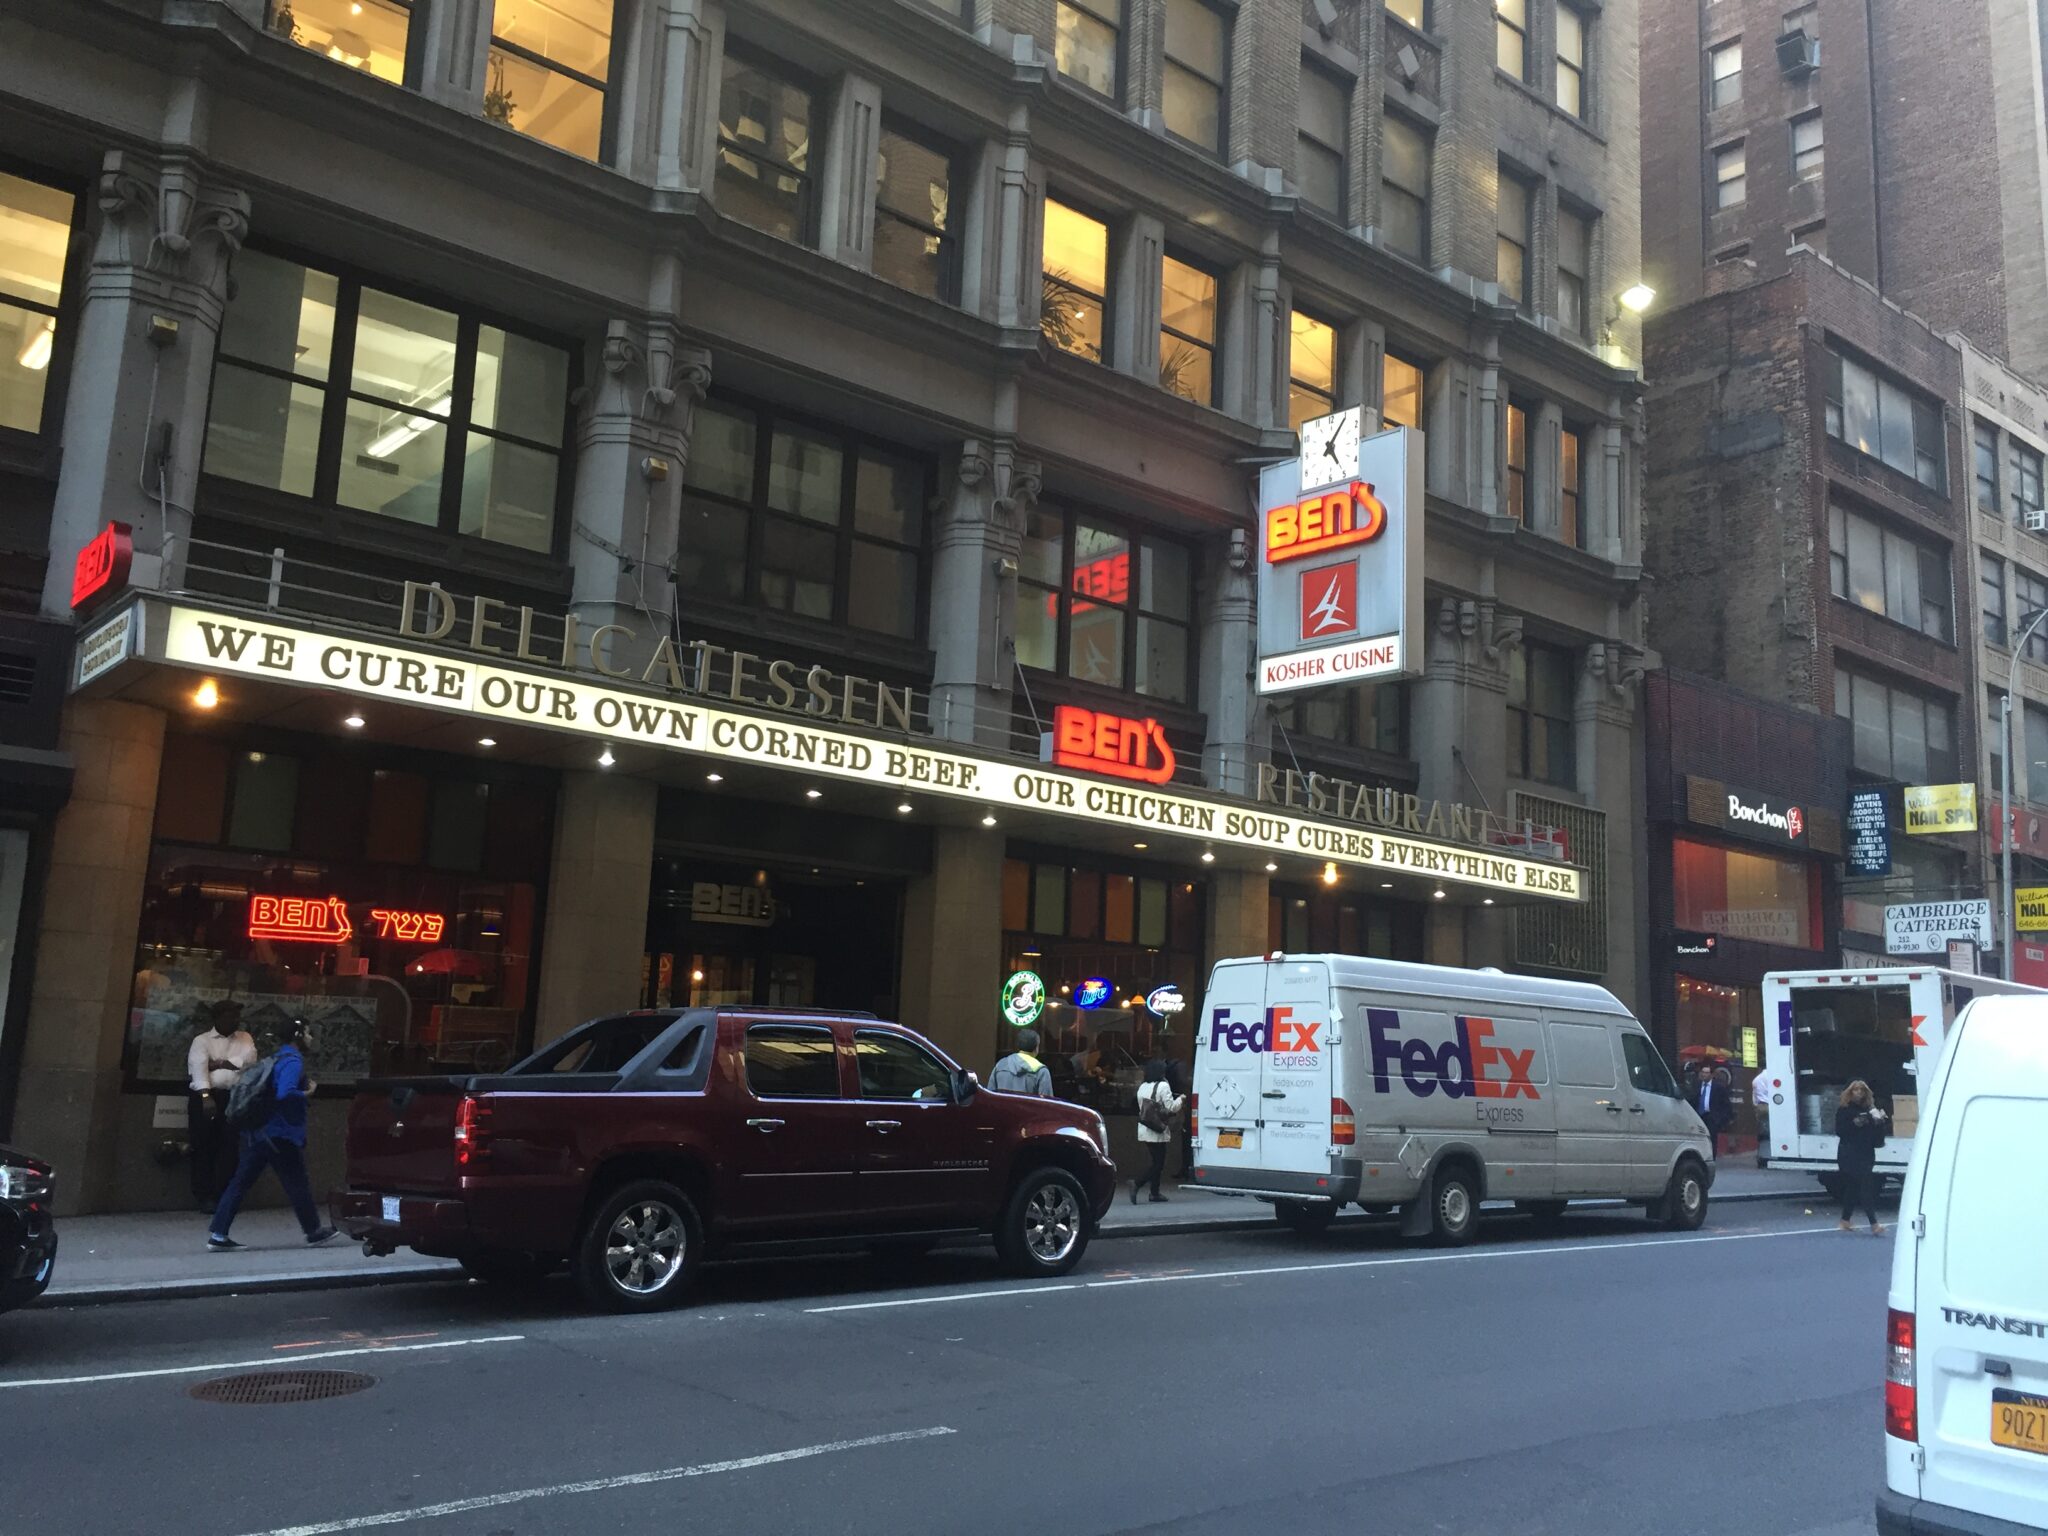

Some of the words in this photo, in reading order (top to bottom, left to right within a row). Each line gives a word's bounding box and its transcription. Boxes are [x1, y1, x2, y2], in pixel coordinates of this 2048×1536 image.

[1315, 419, 1320, 428] 11
[1328, 415, 1334, 424] 12
[1354, 420, 1358, 428] 2
[1354, 437, 1358, 446] 3
[1329, 474, 1333, 482] 6
[1342, 470, 1346, 478] 5
[1266, 481, 1388, 563] BEN'S
[400, 580, 912, 732] DELICATESSEN
[1266, 657, 1325, 683] KOSHER
[1332, 645, 1395, 672] CUISINE
[1053, 705, 1176, 785] BEN'S
[198, 620, 296, 671] WE
[321, 645, 466, 701] CURE
[481, 676, 577, 722] OUR
[594, 697, 698, 742] OWN
[712, 718, 872, 771] CORNED
[885, 749, 981, 792] BEEF.
[1013, 773, 1075, 808] OUR
[1086, 785, 1215, 832] CHICKEN
[1225, 812, 1290, 843] SOUP
[1297, 825, 1374, 859] CURES
[1381, 839, 1518, 884] EVERYTHING
[1524, 866, 1576, 895] ELSE.
[1257, 762, 1493, 846] RESTAURANT
[1728, 795, 1788, 830] Bonchon
[1909, 810, 1942, 826] NAIL
[1945, 808, 1974, 825] SPA
[249, 897, 352, 943] BEN'S
[1886, 901, 1987, 920] CAMBRIDGE
[1894, 916, 1981, 934] CATERERS
[1677, 945, 1710, 954] Bonchon
[1210, 1007, 1322, 1053] FedEx
[1273, 1053, 1319, 1069] Express
[1366, 1008, 1542, 1100] FedEx
[1476, 1101, 1525, 1124] Express
[1941, 1306, 2048, 1338] TRANSIT
